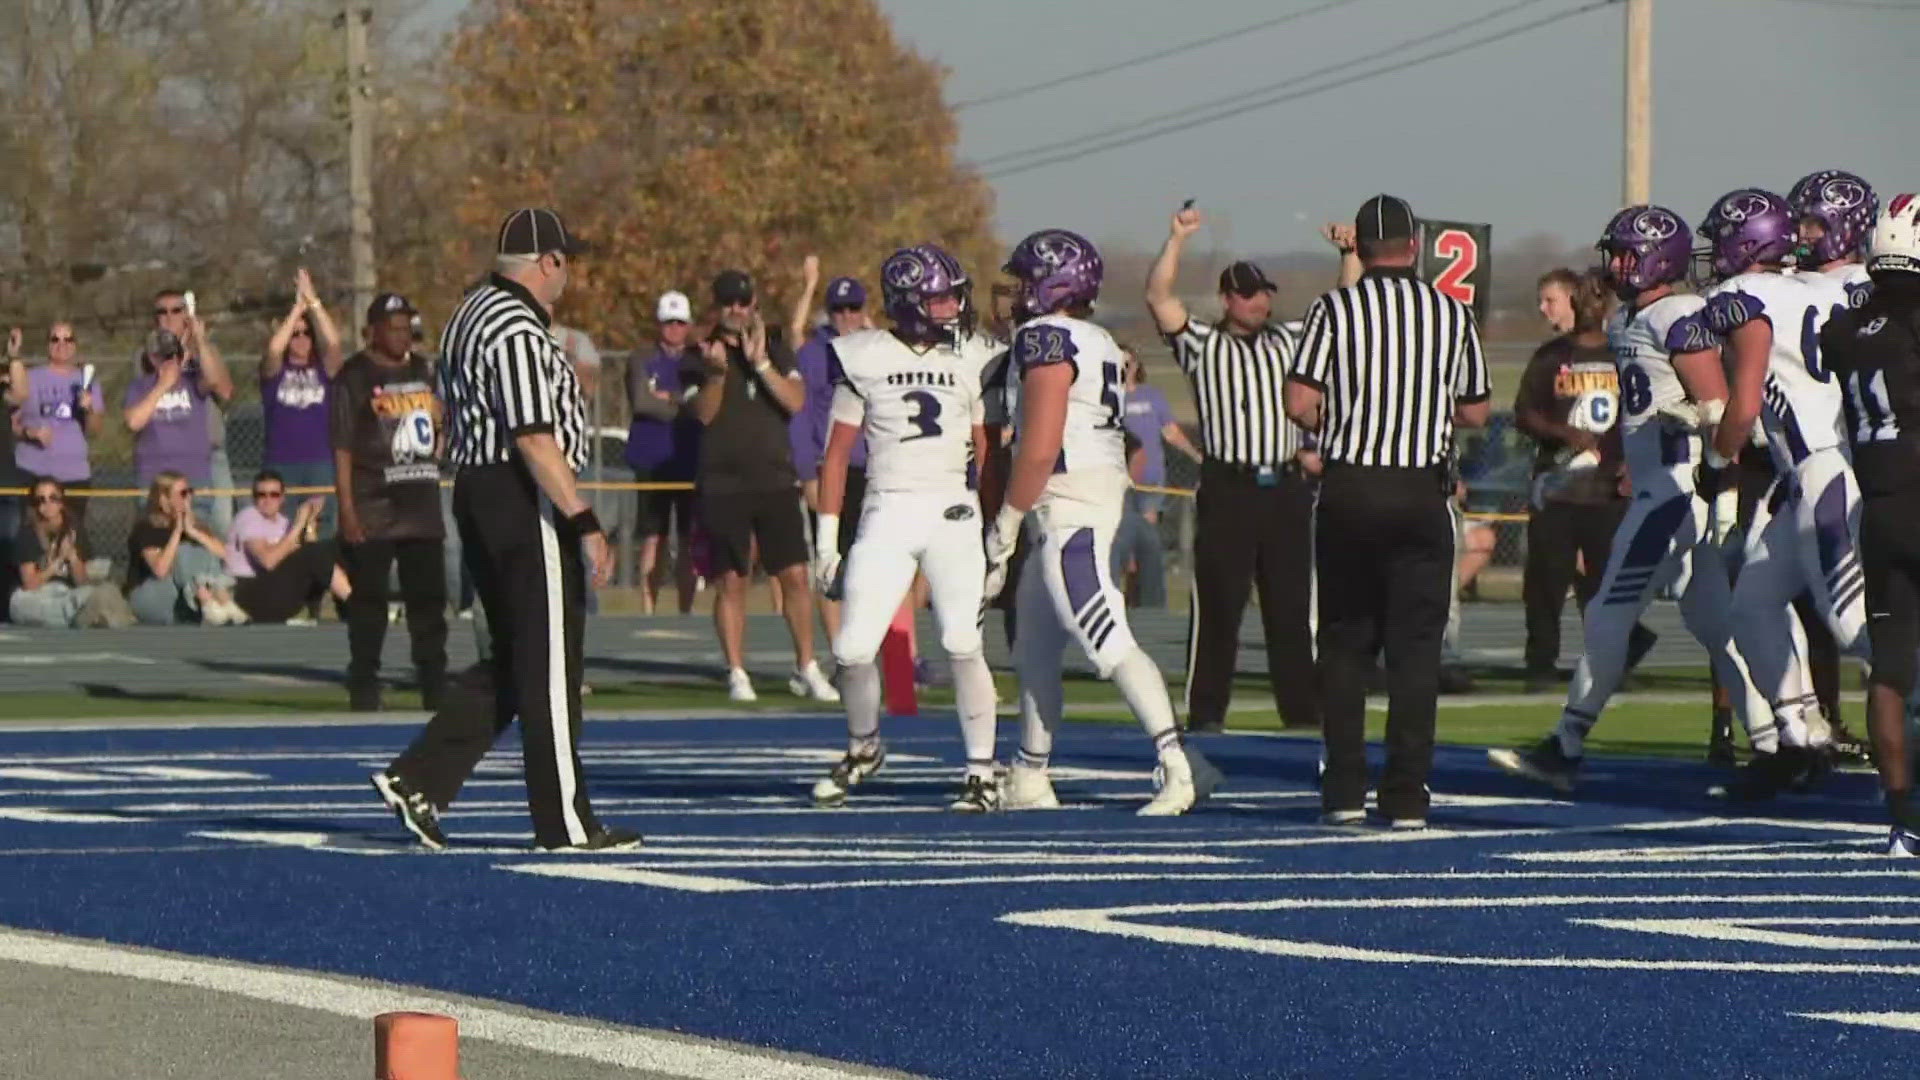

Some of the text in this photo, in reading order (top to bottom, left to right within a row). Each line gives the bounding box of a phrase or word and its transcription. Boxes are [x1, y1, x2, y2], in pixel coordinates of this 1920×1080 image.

[1433, 229, 1478, 306] 2
[1024, 331, 1064, 362] 52
[887, 370, 956, 387] CENTRAL
[1093, 360, 1127, 431] 5
[1590, 396, 1610, 423] C
[413, 416, 432, 446] C
[899, 389, 943, 443] 3
